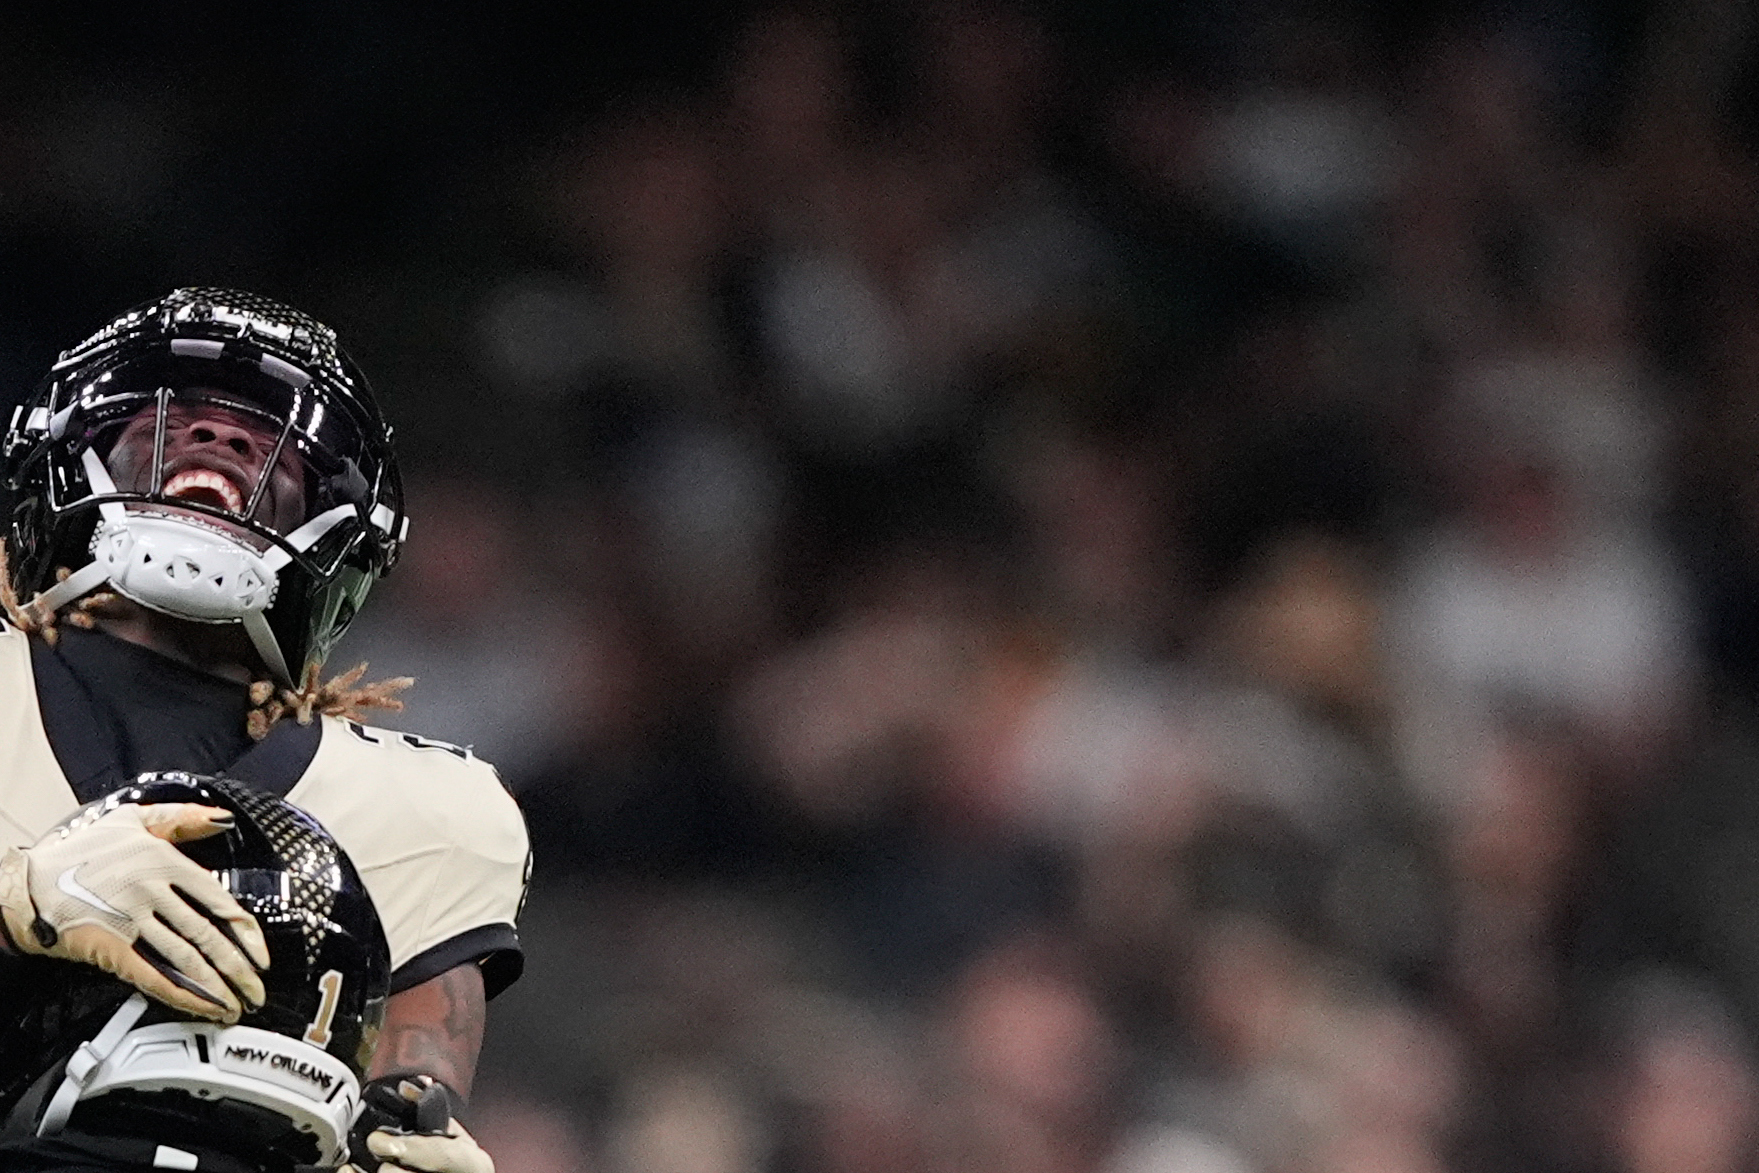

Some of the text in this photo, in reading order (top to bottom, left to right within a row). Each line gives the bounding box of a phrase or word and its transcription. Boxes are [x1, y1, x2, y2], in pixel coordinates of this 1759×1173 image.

[302, 969, 343, 1050] 1
[224, 1045, 334, 1089] NEW ORLEANS
